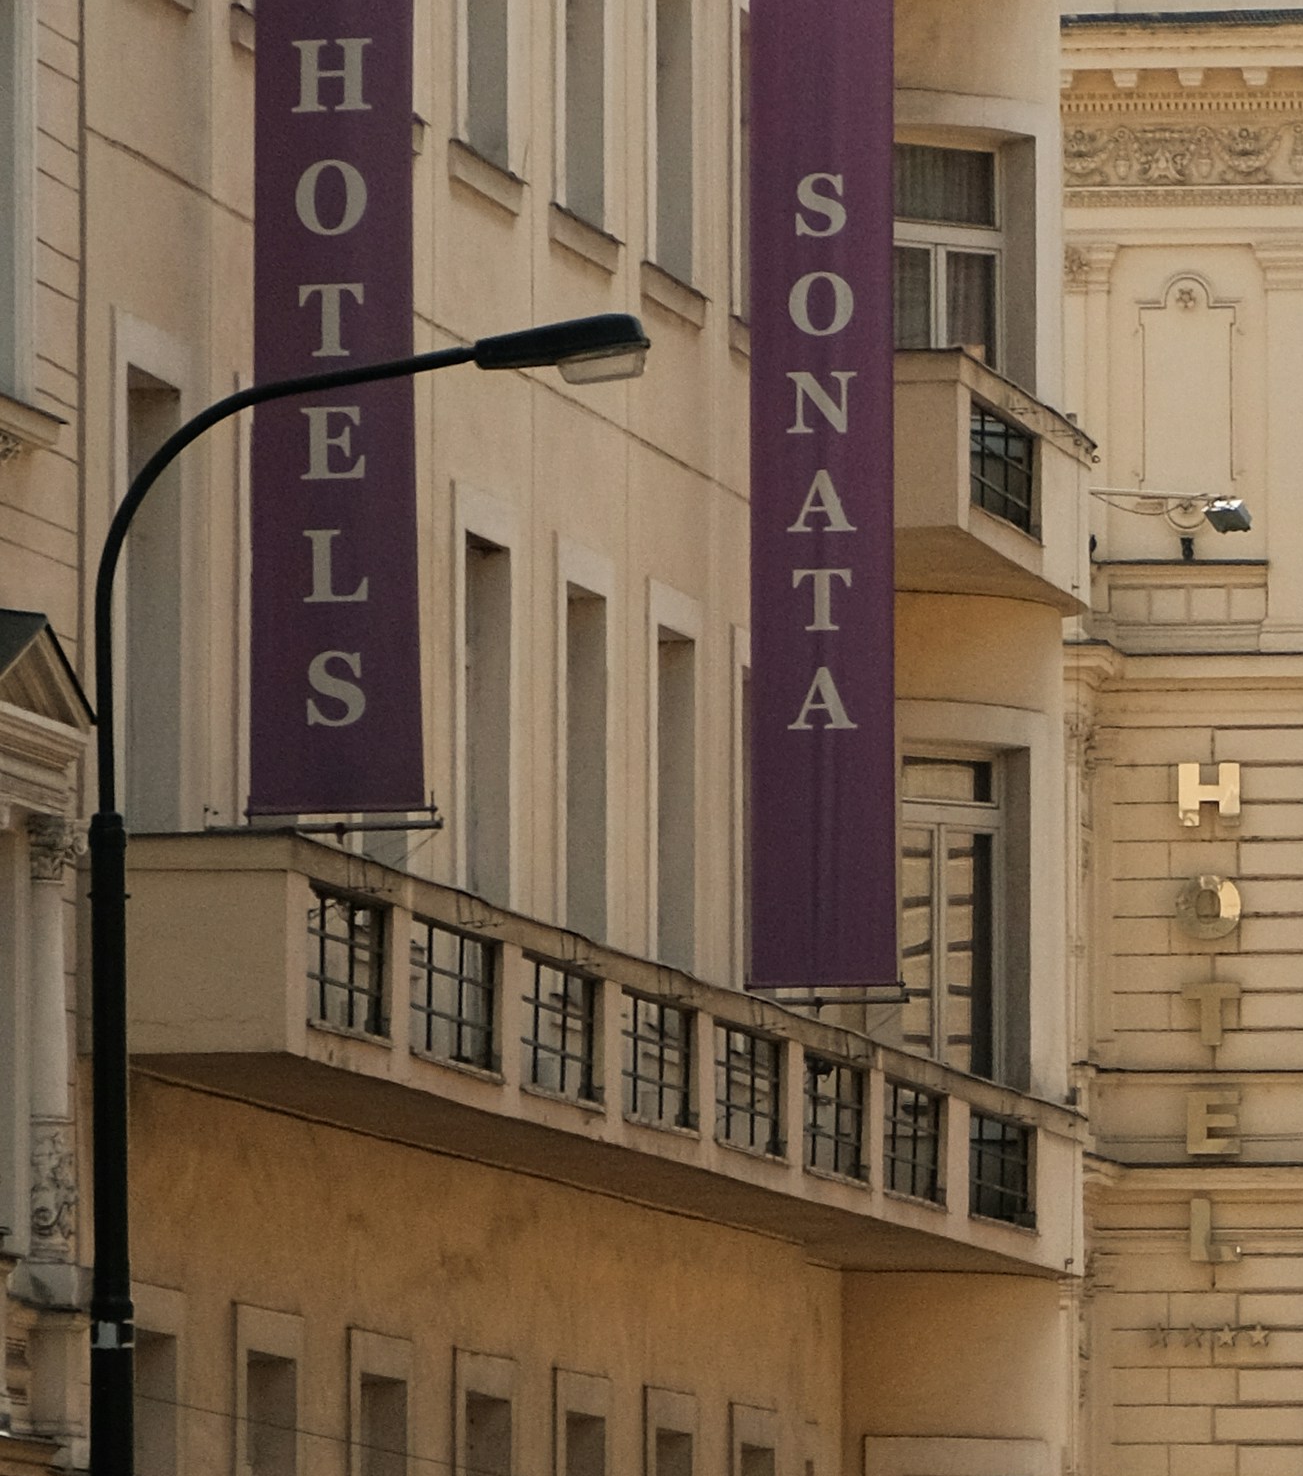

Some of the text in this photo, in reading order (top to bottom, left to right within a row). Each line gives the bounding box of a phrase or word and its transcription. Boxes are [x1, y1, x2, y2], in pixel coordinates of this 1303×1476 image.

[291, 37, 372, 727] HOTELS
[786, 172, 858, 730] SONATA
[1174, 762, 1242, 1262] HOTEL
